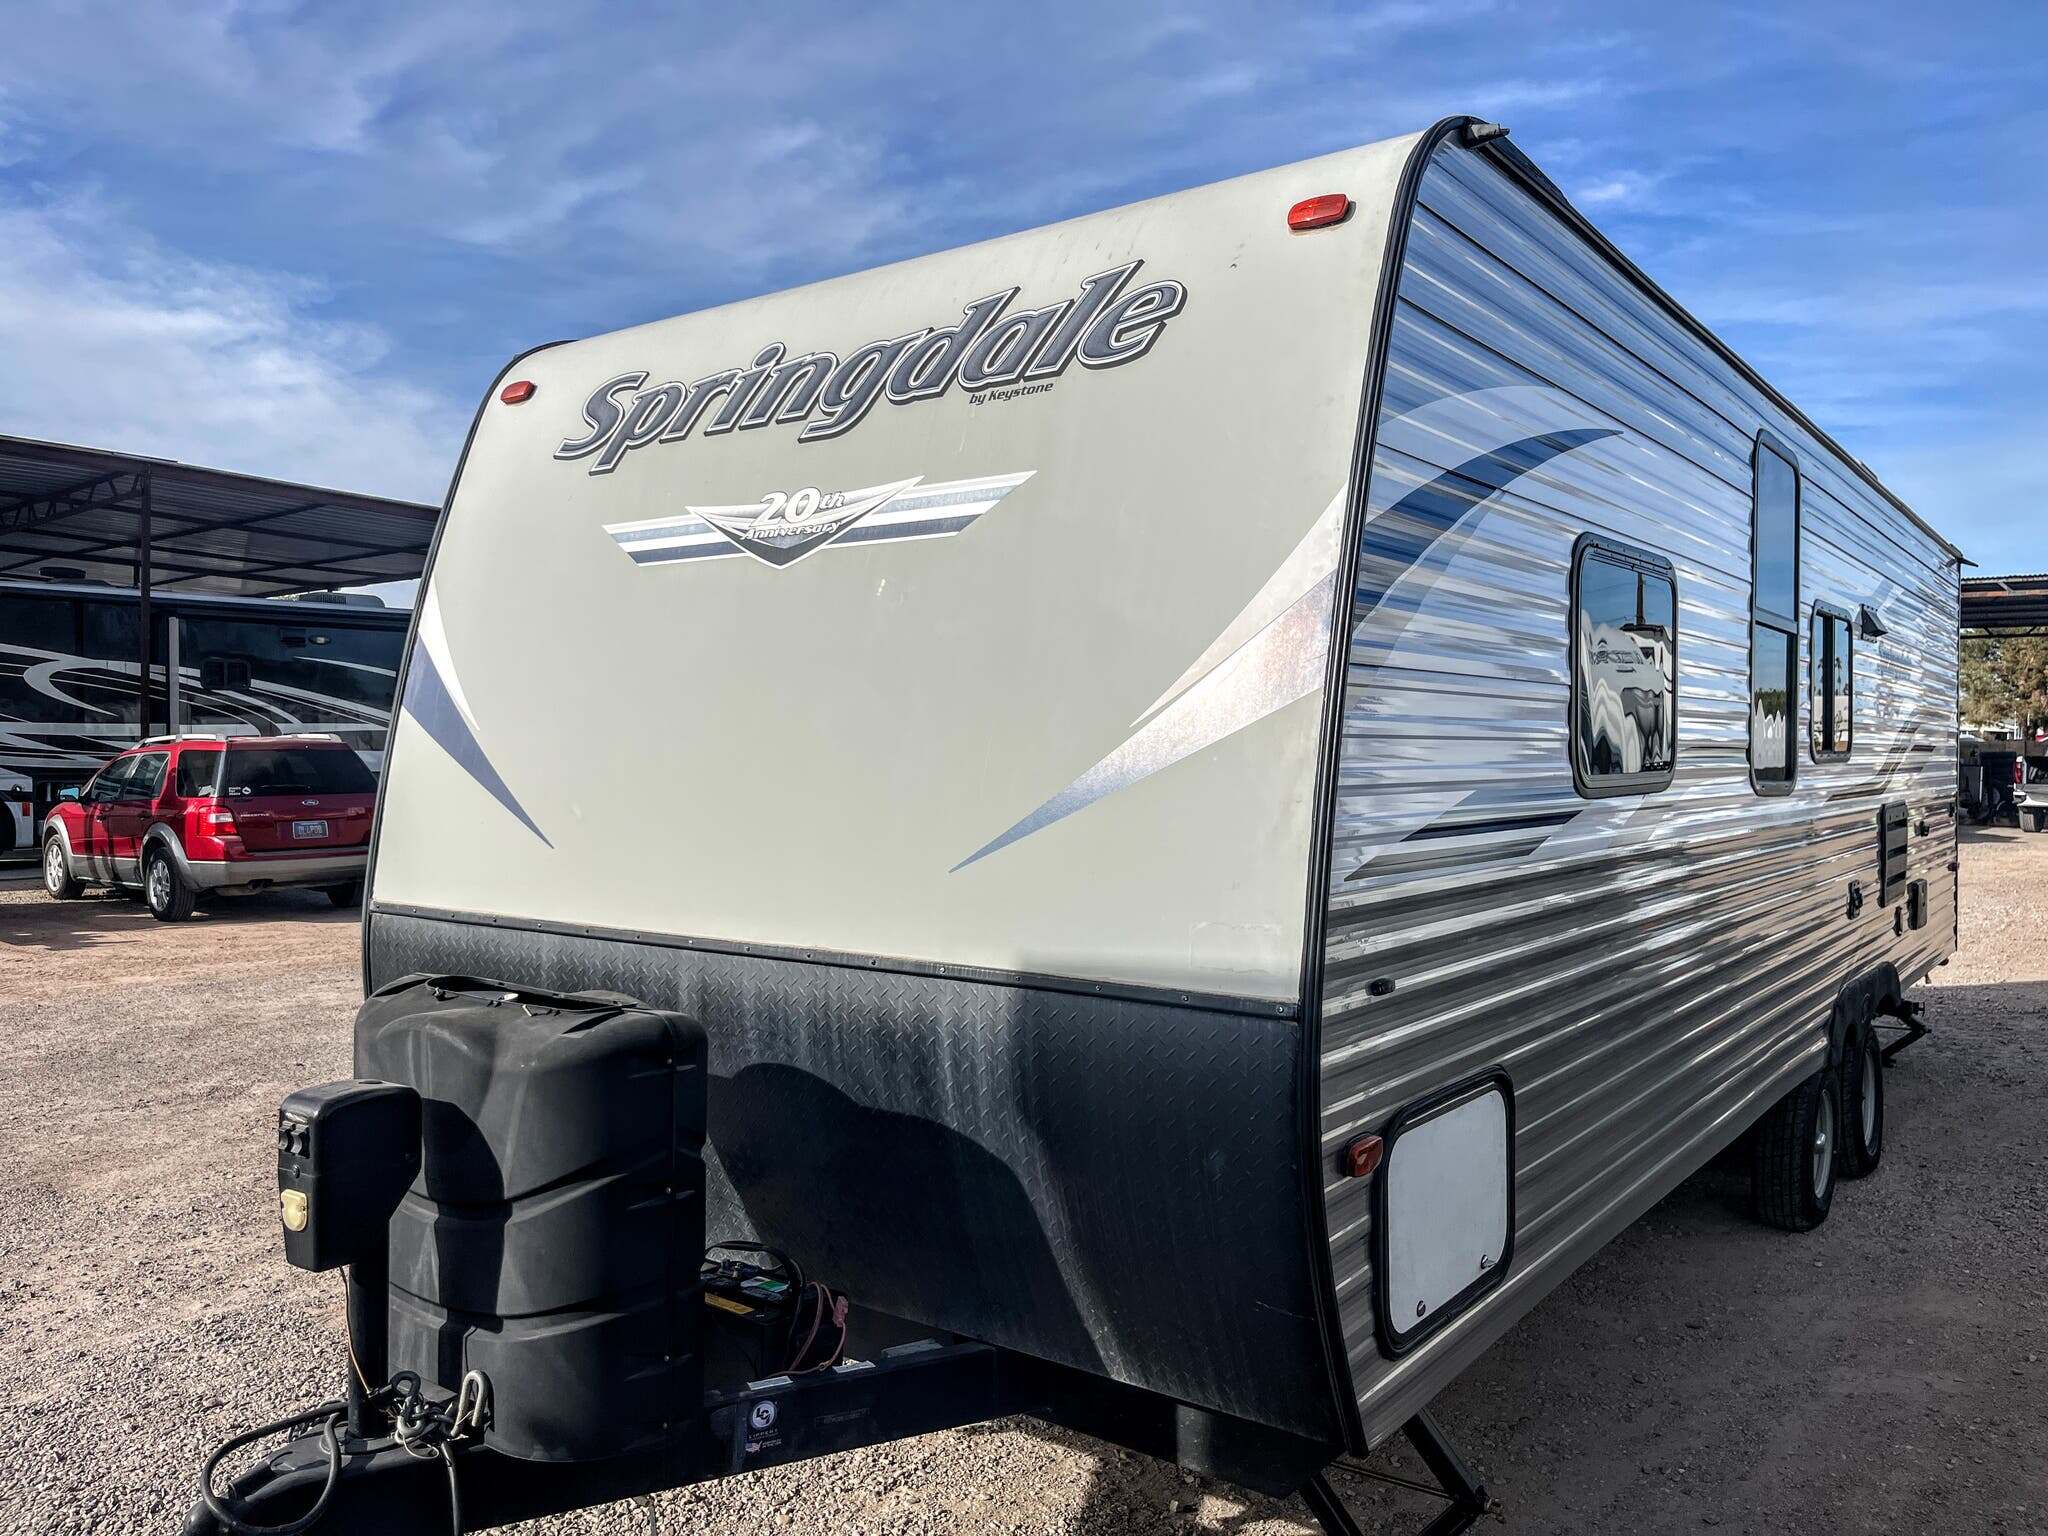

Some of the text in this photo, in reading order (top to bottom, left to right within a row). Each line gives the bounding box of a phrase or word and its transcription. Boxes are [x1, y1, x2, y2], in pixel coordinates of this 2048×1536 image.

[554, 259, 1188, 475] Springdale
[969, 383, 1054, 406] by Keystone
[749, 486, 845, 527] 20th
[740, 521, 841, 541] Anniversary
